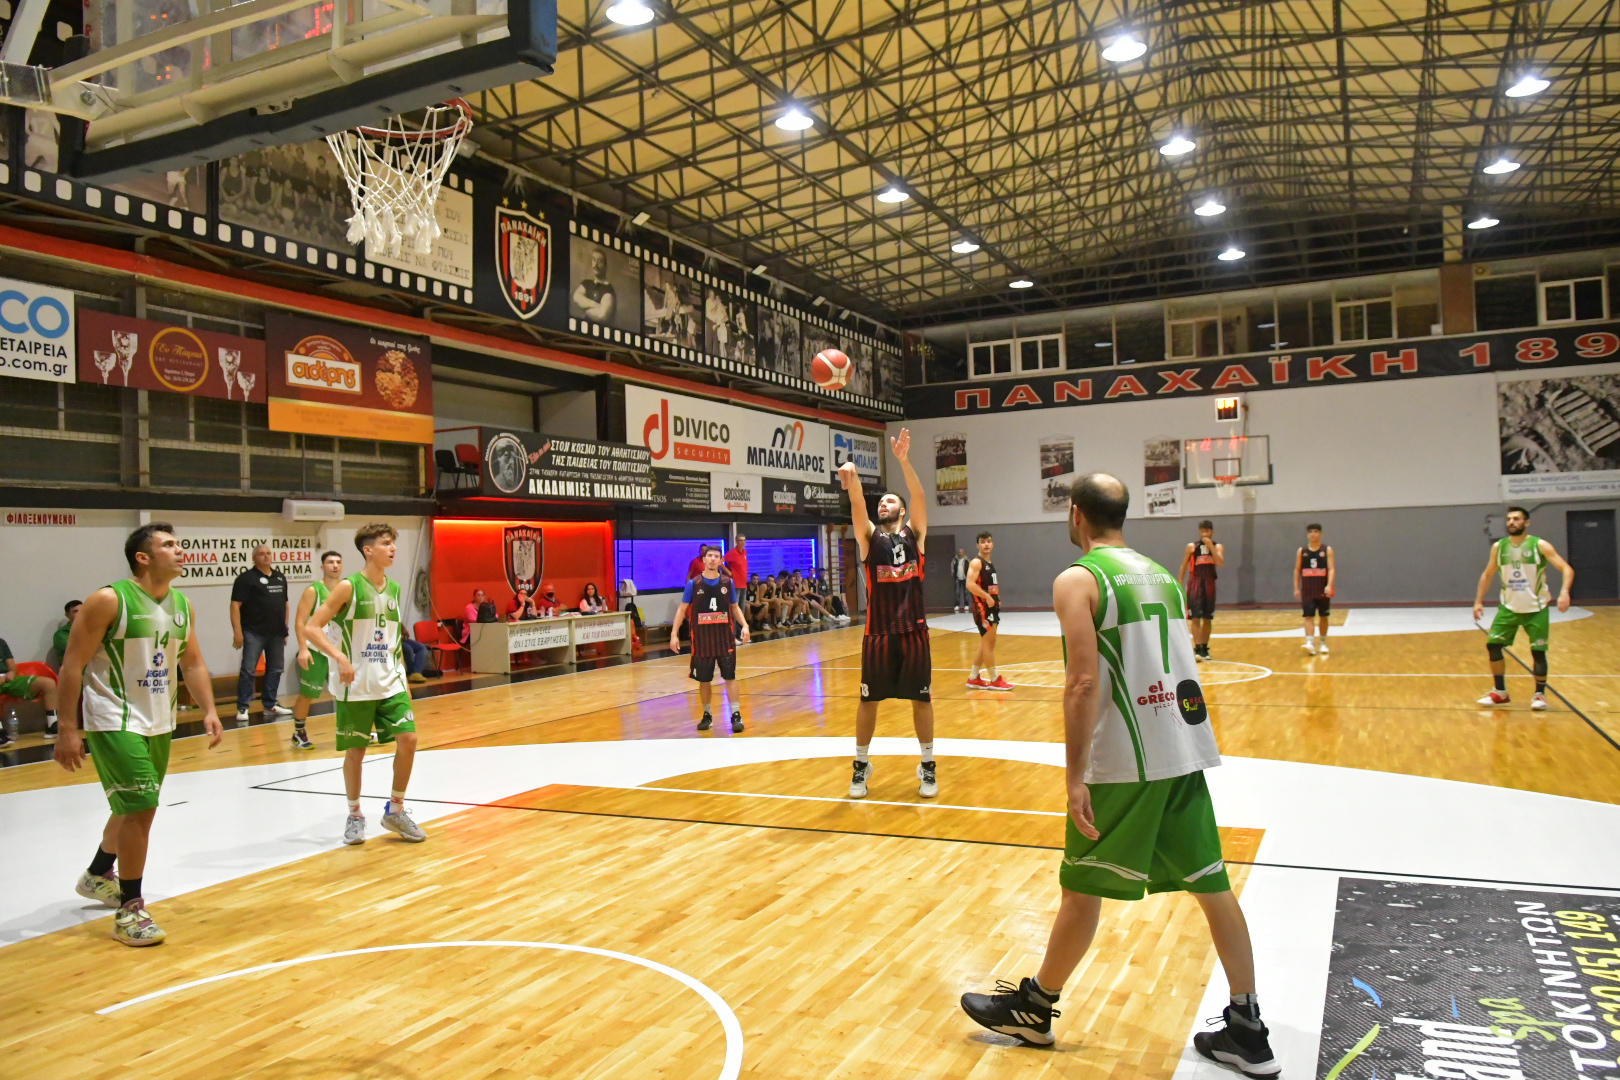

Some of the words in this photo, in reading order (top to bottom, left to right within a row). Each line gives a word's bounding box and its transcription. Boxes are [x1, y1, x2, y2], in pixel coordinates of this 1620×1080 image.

[514, 290, 534, 305] 1891
[953, 347, 1419, 412] ΠΑΝΑΧΑΪΚΗ
[1457, 331, 1620, 368] 189
[673, 415, 731, 444] DIVICO
[550, 439, 570, 452] ΣΤΟΝ
[571, 442, 596, 455] ΚΟΣΜΟ
[598, 445, 611, 456] ΤΟΥ
[611, 447, 651, 461] ΑΘΛΗΤΙΣΜΟΥ
[676, 447, 729, 463] security
[551, 454, 565, 466] ΤΗΣ
[566, 456, 598, 470] ΠΑΙΔΕΙΑΣ
[599, 460, 612, 470] ΤΟΥ
[612, 460, 651, 474] ΠΟΛΙΤΙΣΜΟΥ
[746, 445, 825, 474] ΜΠΑΚΑΛΑΡΟΣ
[528, 478, 591, 497] ΑΚΑΔΗΜΙΕΣ
[593, 482, 652, 501] ΠΑΝΑΧΑΪΚΗΣ
[6, 513, 76, 525] ΦΙΛΟΞΕΝΟΥΜΕΝΟΙ
[180, 538, 236, 550] ΘΛΗΤΗΣ
[272, 538, 311, 549] ΠΑΙΖΕΙ
[222, 552, 247, 563] ΔΕΝ
[280, 551, 312, 562] ΘΕΣΗ
[1310, 558, 1318, 568] 5
[708, 597, 718, 611] 4
[375, 613, 386, 628] 16
[154, 630, 170, 649] 14
[1140, 602, 1171, 674] 7
[1148, 681, 1164, 692] el
[1137, 691, 1175, 705] GRECO
[1555, 910, 1617, 942] 149
